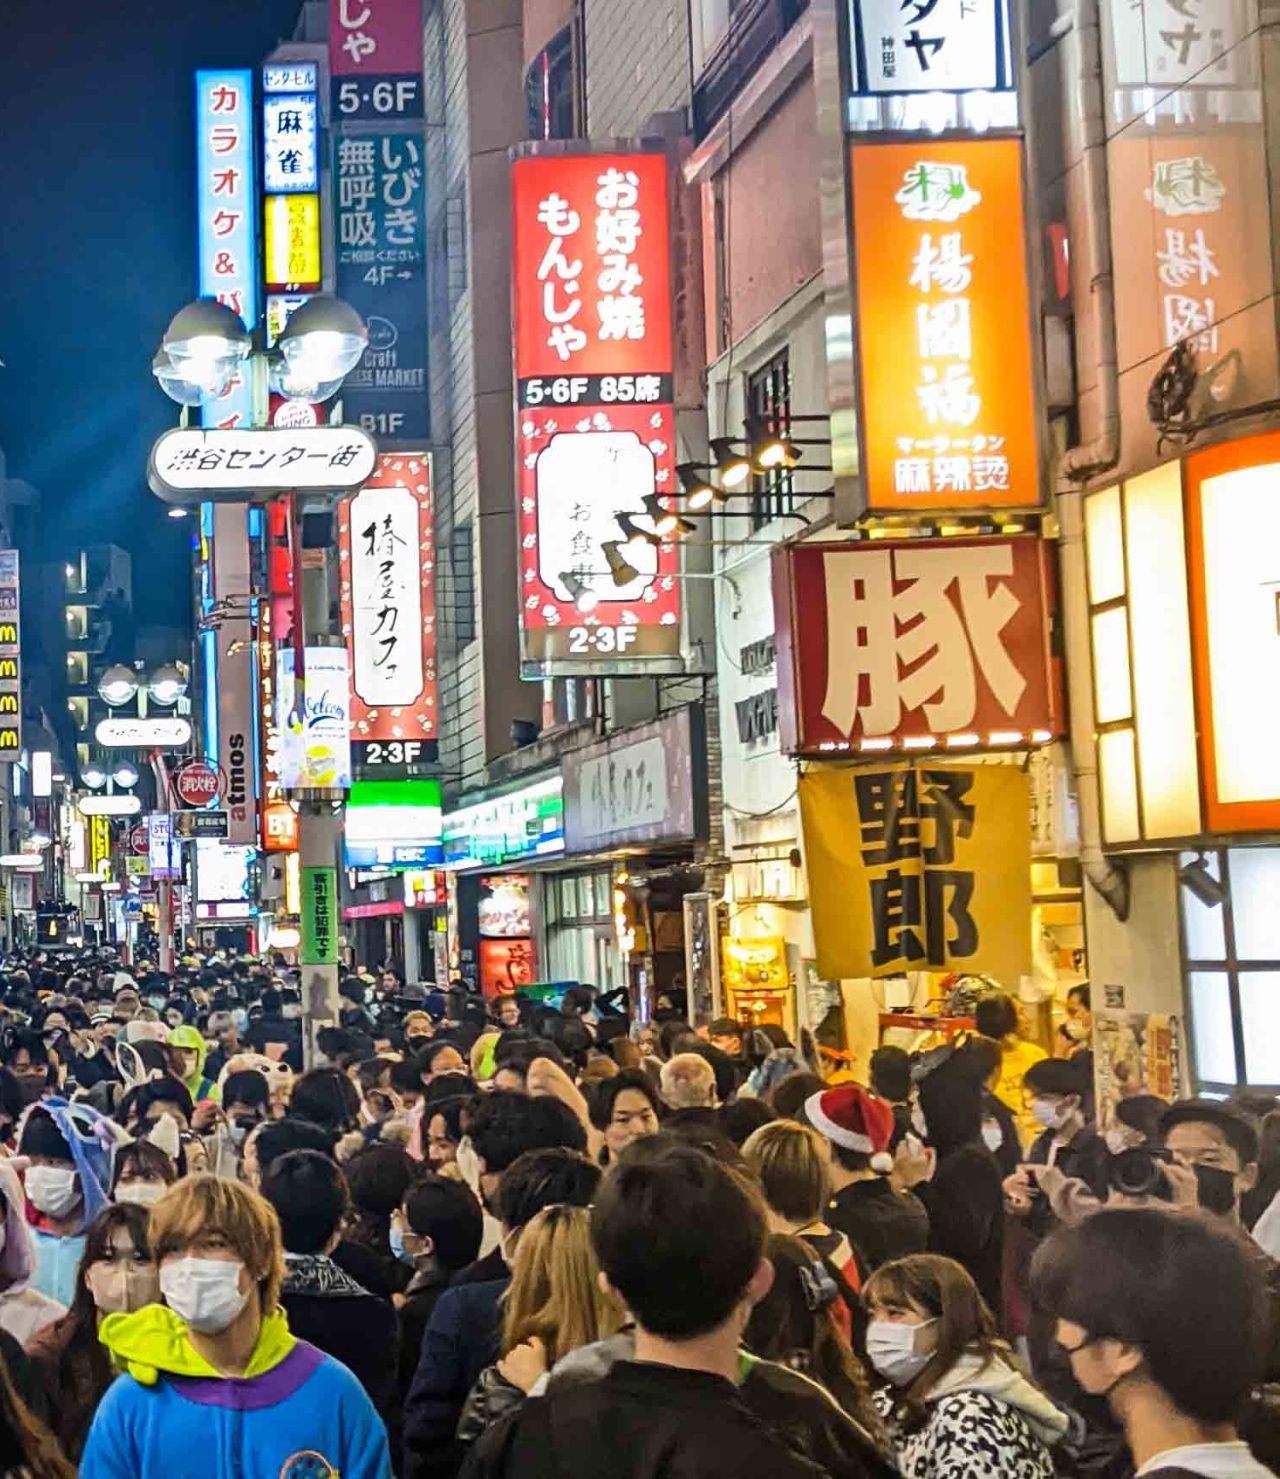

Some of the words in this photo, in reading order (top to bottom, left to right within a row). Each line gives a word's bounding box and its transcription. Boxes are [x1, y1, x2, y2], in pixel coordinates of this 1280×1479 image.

[277, 110, 304, 175] 麻雀
[339, 140, 376, 247] 無呼吸
[382, 137, 422, 245] いびき
[364, 266, 395, 286] 4F
[595, 167, 645, 340] お好み焼
[364, 350, 397, 367] Craft
[375, 368, 424, 386] MARKET
[600, 375, 661, 402] 85席
[167, 444, 363, 471] 渋谷センター街
[896, 436, 1005, 453] マーラータン
[821, 544, 1027, 738] 豚
[181, 777, 217, 793] 消火栓
[227, 733, 245, 822] atmos
[854, 771, 978, 968] 野郎
